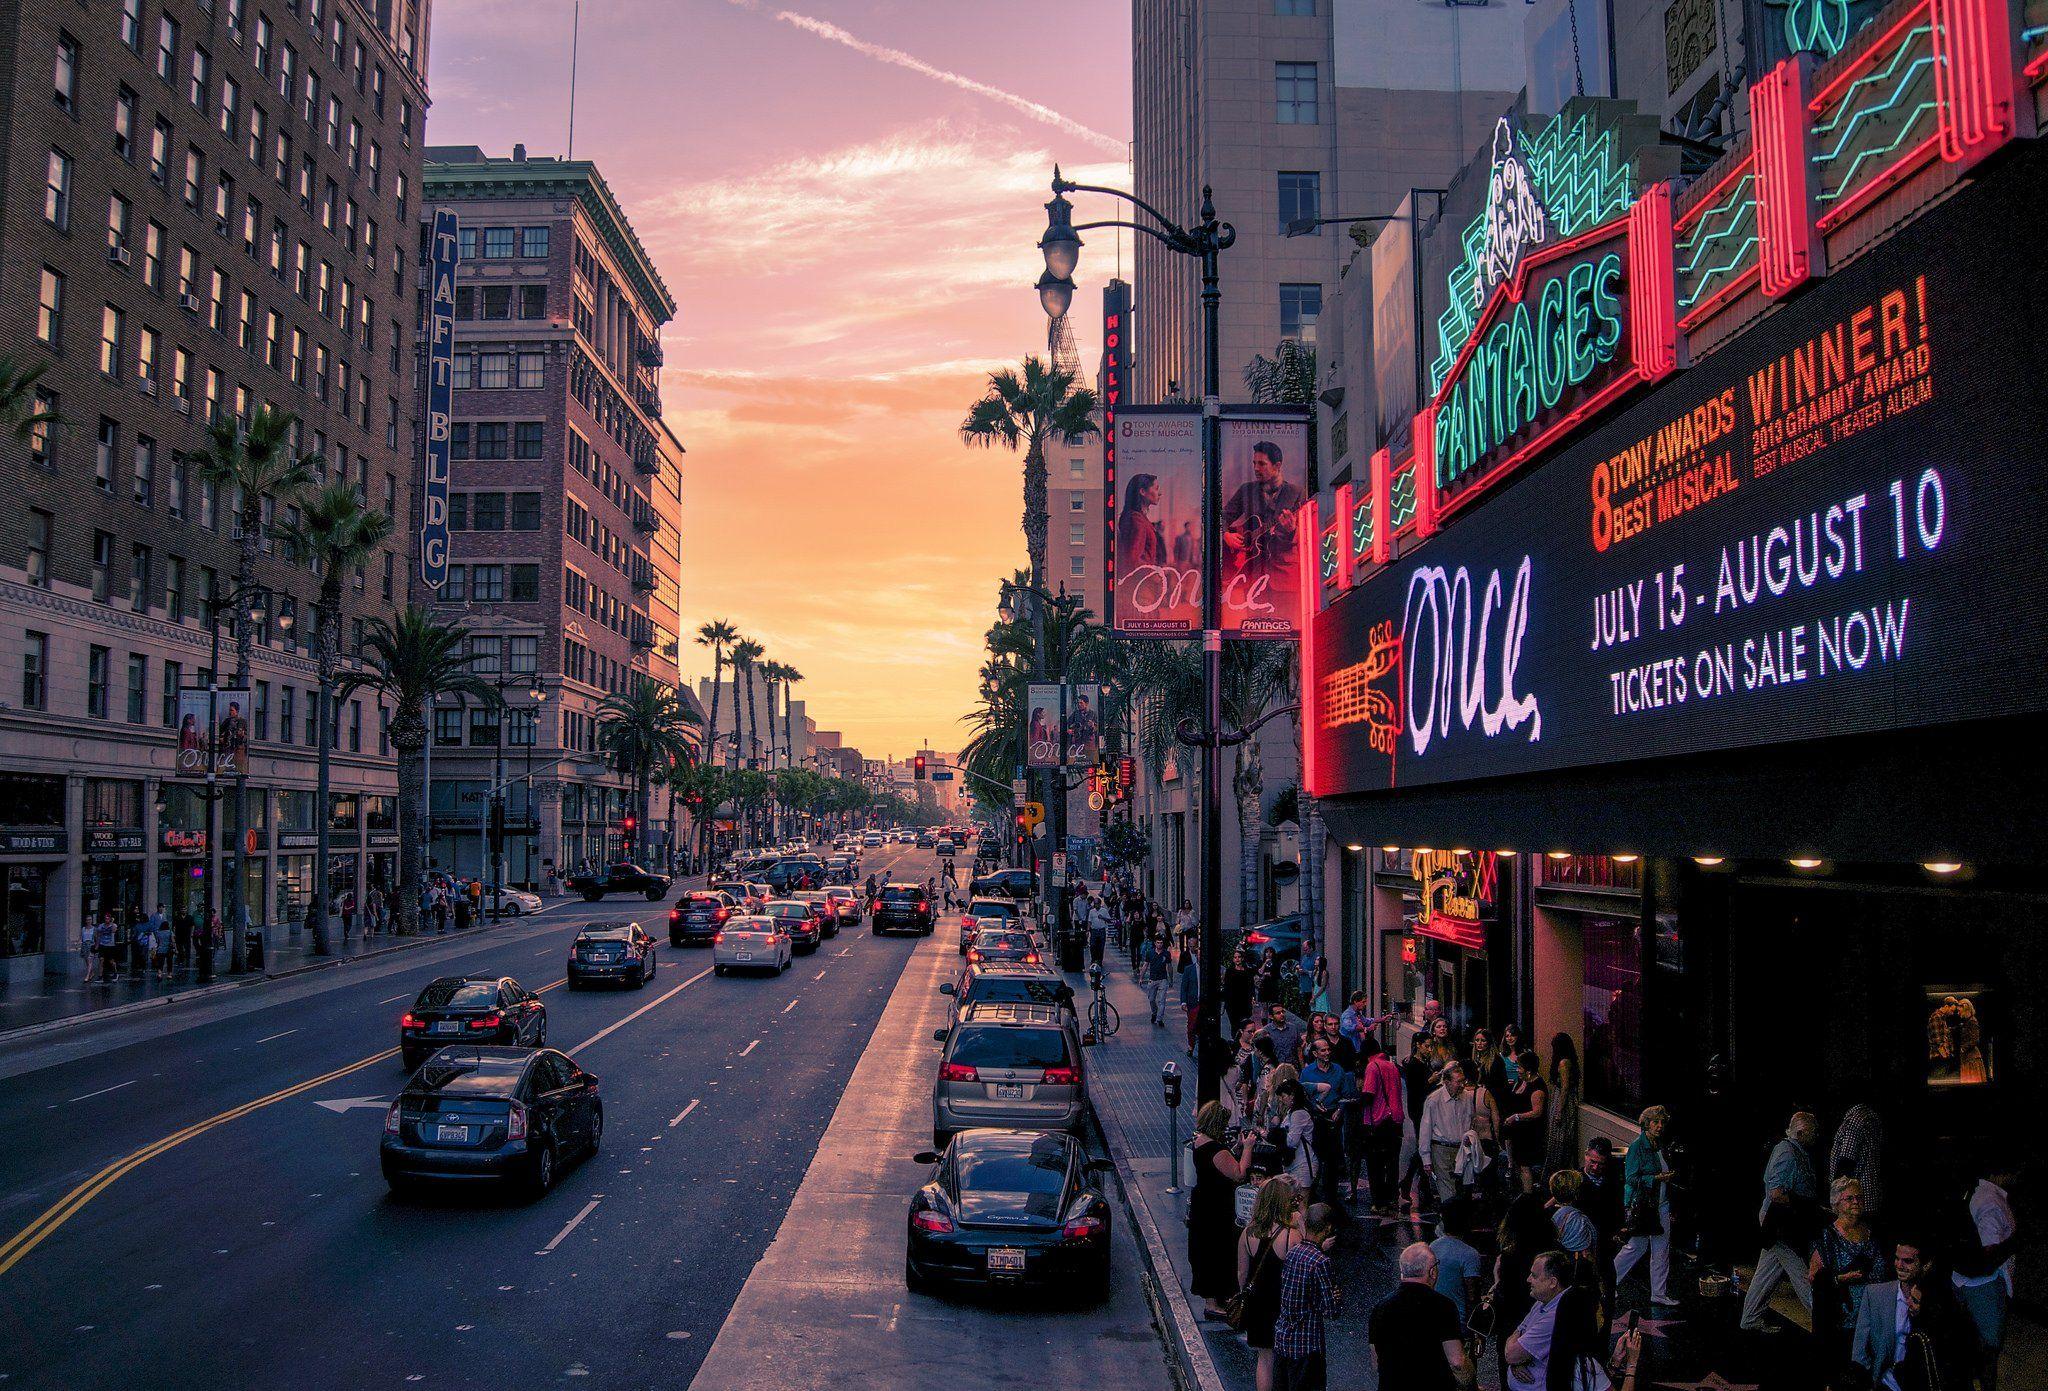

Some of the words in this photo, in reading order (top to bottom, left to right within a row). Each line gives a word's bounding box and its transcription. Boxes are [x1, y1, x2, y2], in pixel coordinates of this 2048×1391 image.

[432, 233, 456, 387] TAFT
[1748, 274, 1928, 426] WINNER!
[1133, 421, 1156, 429] TONY
[1158, 421, 1195, 429] AWARDS
[1436, 254, 1622, 488] PANTAGES
[1753, 418, 1782, 455] 2013
[1863, 342, 1931, 402] AWARD
[1122, 421, 1133, 437] 8
[1609, 435, 1652, 494] TONY
[1655, 388, 1737, 471] AWARDS
[1753, 450, 1777, 479] BEST
[1781, 428, 1828, 466] MUSICAL
[1830, 401, 1883, 442] THEATER
[1886, 375, 1933, 418] ALBUM
[426, 413, 449, 568] BLDG
[1592, 461, 1612, 552] 8
[1613, 490, 1654, 543] BEST
[1657, 451, 1740, 523] MUSICAL
[1591, 579, 1643, 651] JULY
[1655, 564, 1686, 631] 15
[1715, 493, 1868, 614] AUGUST
[1889, 468, 1945, 559] 10
[1242, 620, 1291, 630] PANTAGES
[1610, 656, 1688, 715] TICKETS
[1695, 644, 1735, 699] ON
[1743, 626, 1807, 690] SALE
[1818, 598, 1910, 677] NOW
